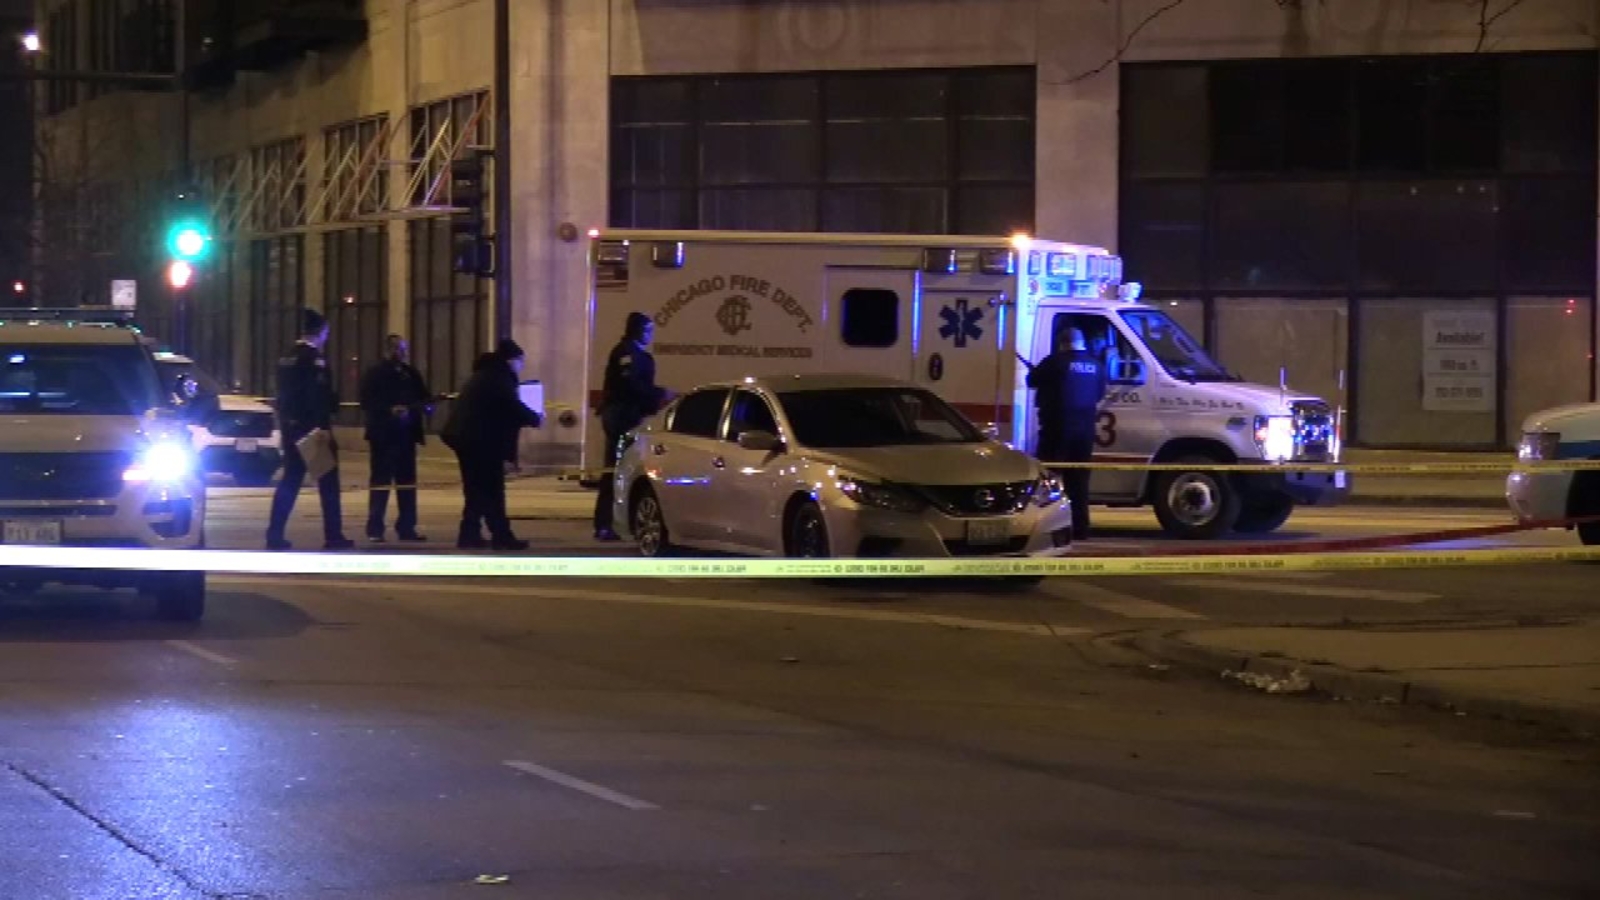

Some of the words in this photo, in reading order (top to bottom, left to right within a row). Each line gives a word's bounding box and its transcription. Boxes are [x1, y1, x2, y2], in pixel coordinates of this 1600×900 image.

[654, 275, 725, 327] CHICAGO
[730, 275, 771, 298] FIRE
[717, 345, 761, 356] MEDICAL
[763, 347, 813, 358] SERVICES
[1069, 361, 1096, 374] POLICE
